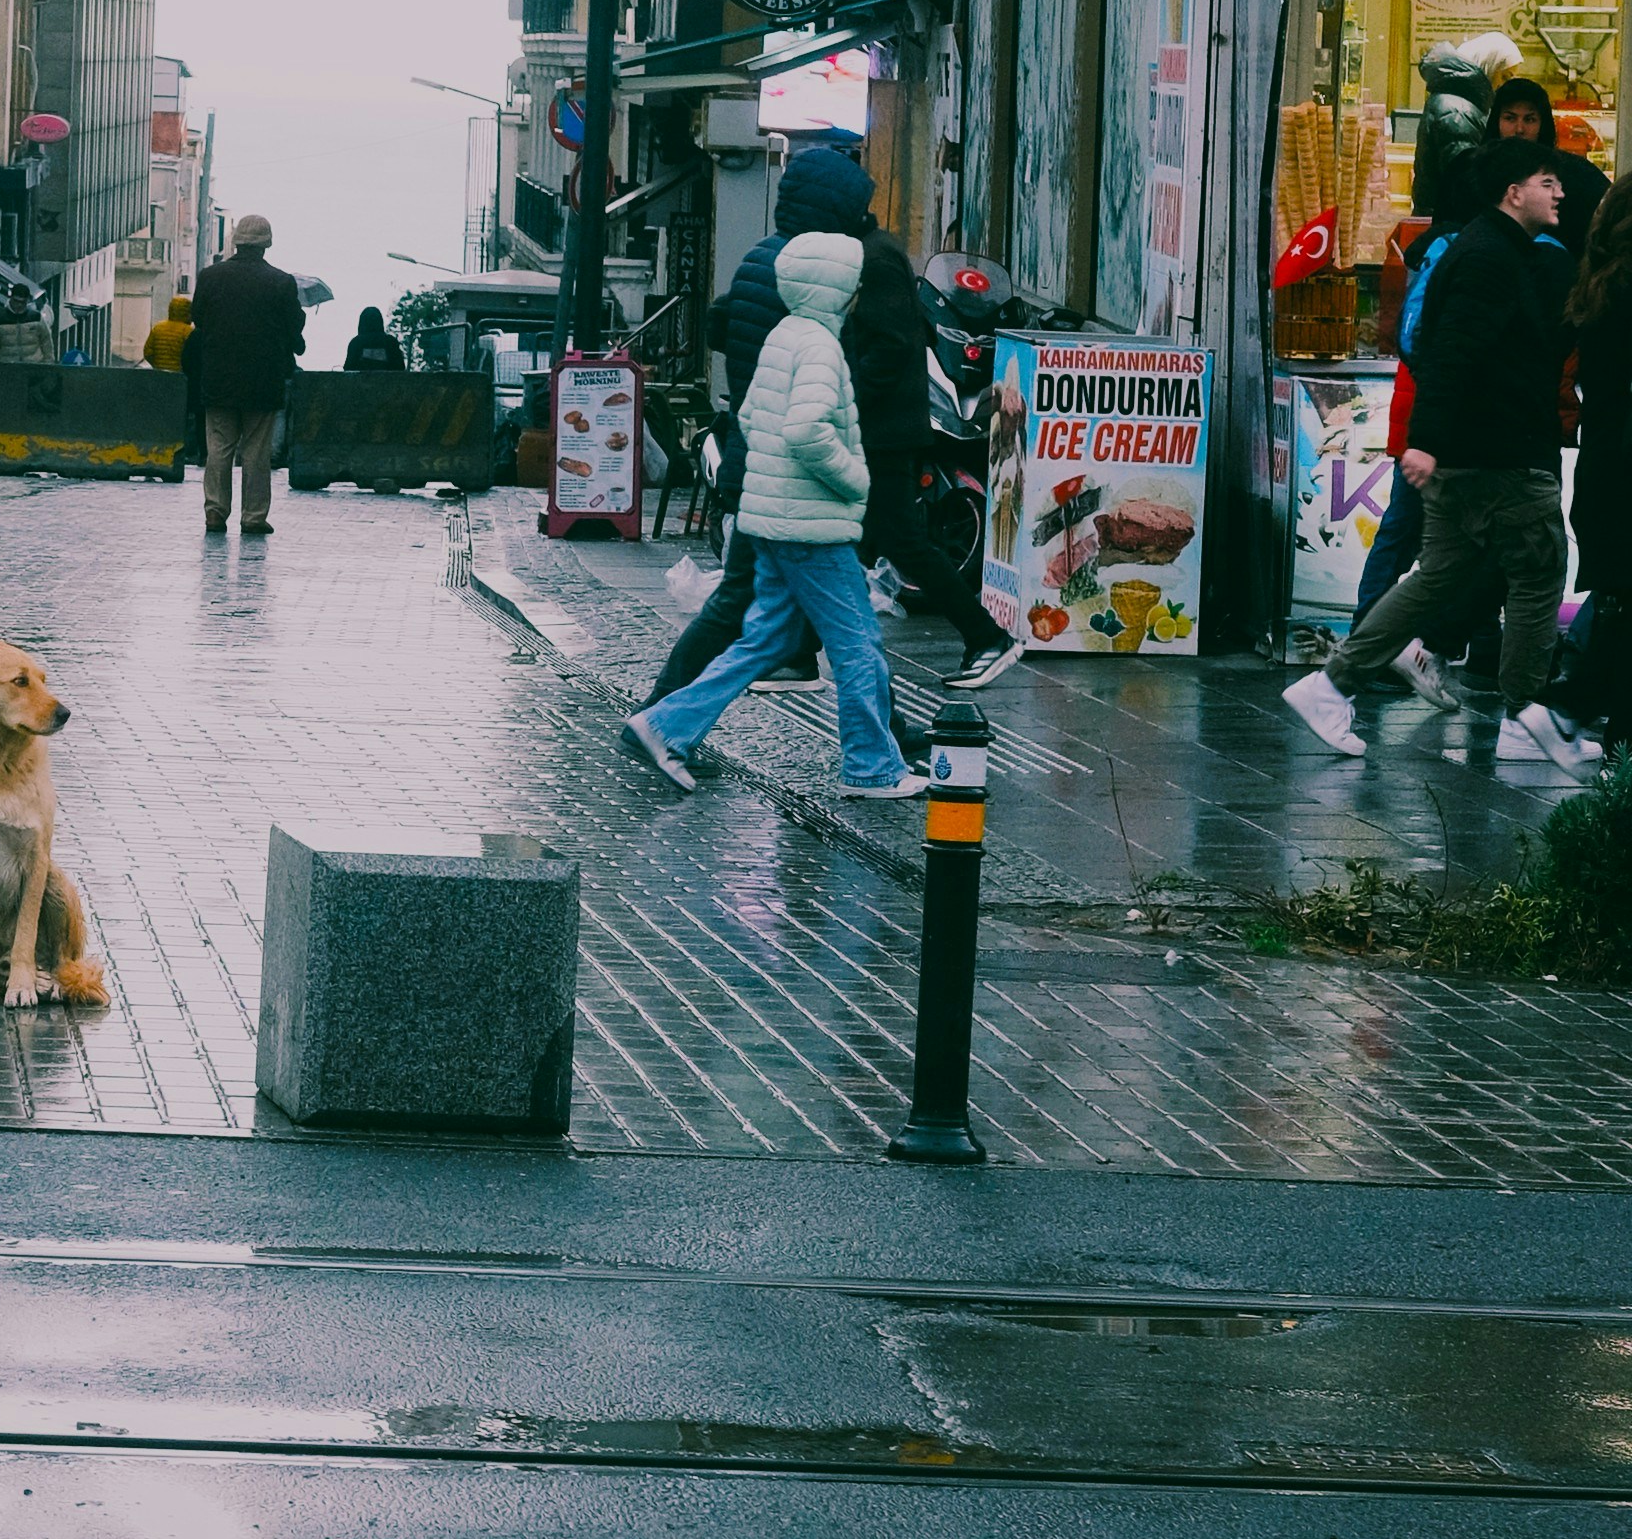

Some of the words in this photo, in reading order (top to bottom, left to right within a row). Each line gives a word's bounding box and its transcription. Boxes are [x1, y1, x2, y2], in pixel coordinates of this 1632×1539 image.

[1038, 348, 1205, 377] KAHRAMANMARAŞ
[1035, 373, 1203, 418] DONDURMA
[1036, 420, 1088, 461] ICE
[1092, 421, 1199, 465] CREAM
